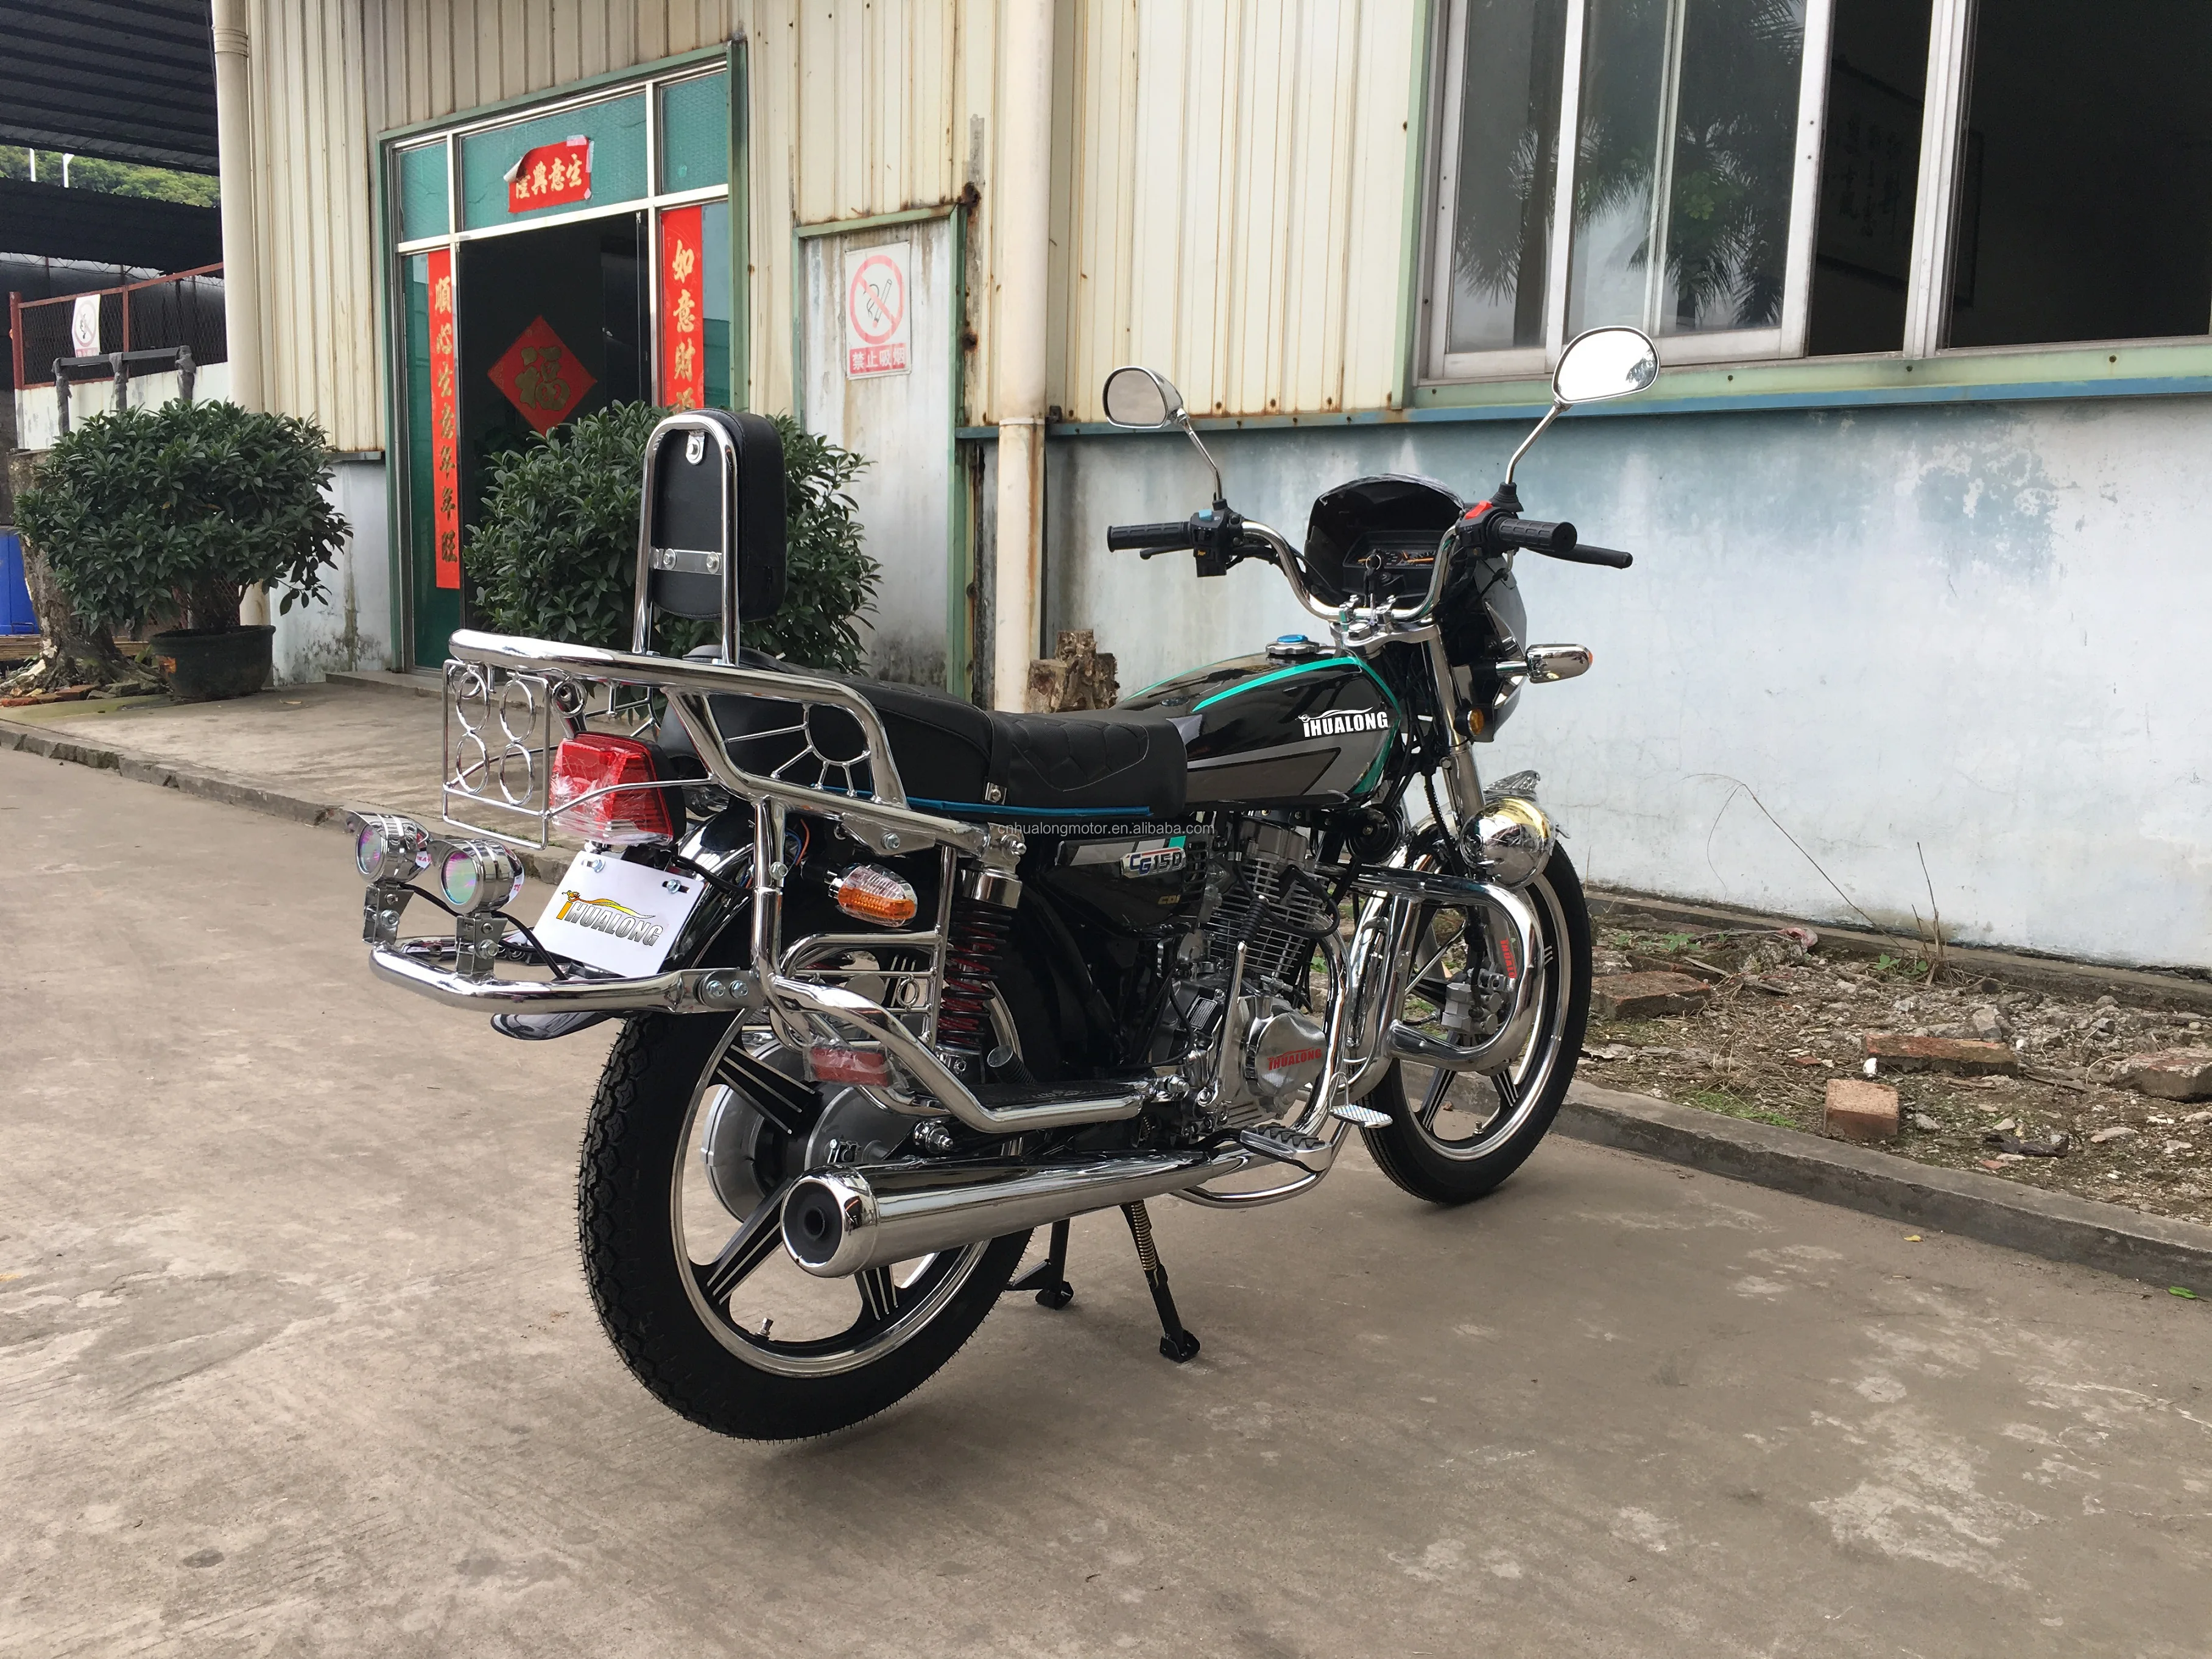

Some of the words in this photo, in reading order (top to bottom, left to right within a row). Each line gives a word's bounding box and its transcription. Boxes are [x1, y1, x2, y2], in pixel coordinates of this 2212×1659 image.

[515, 346, 571, 411] 福
[852, 347, 906, 370] 禁止吸烟
